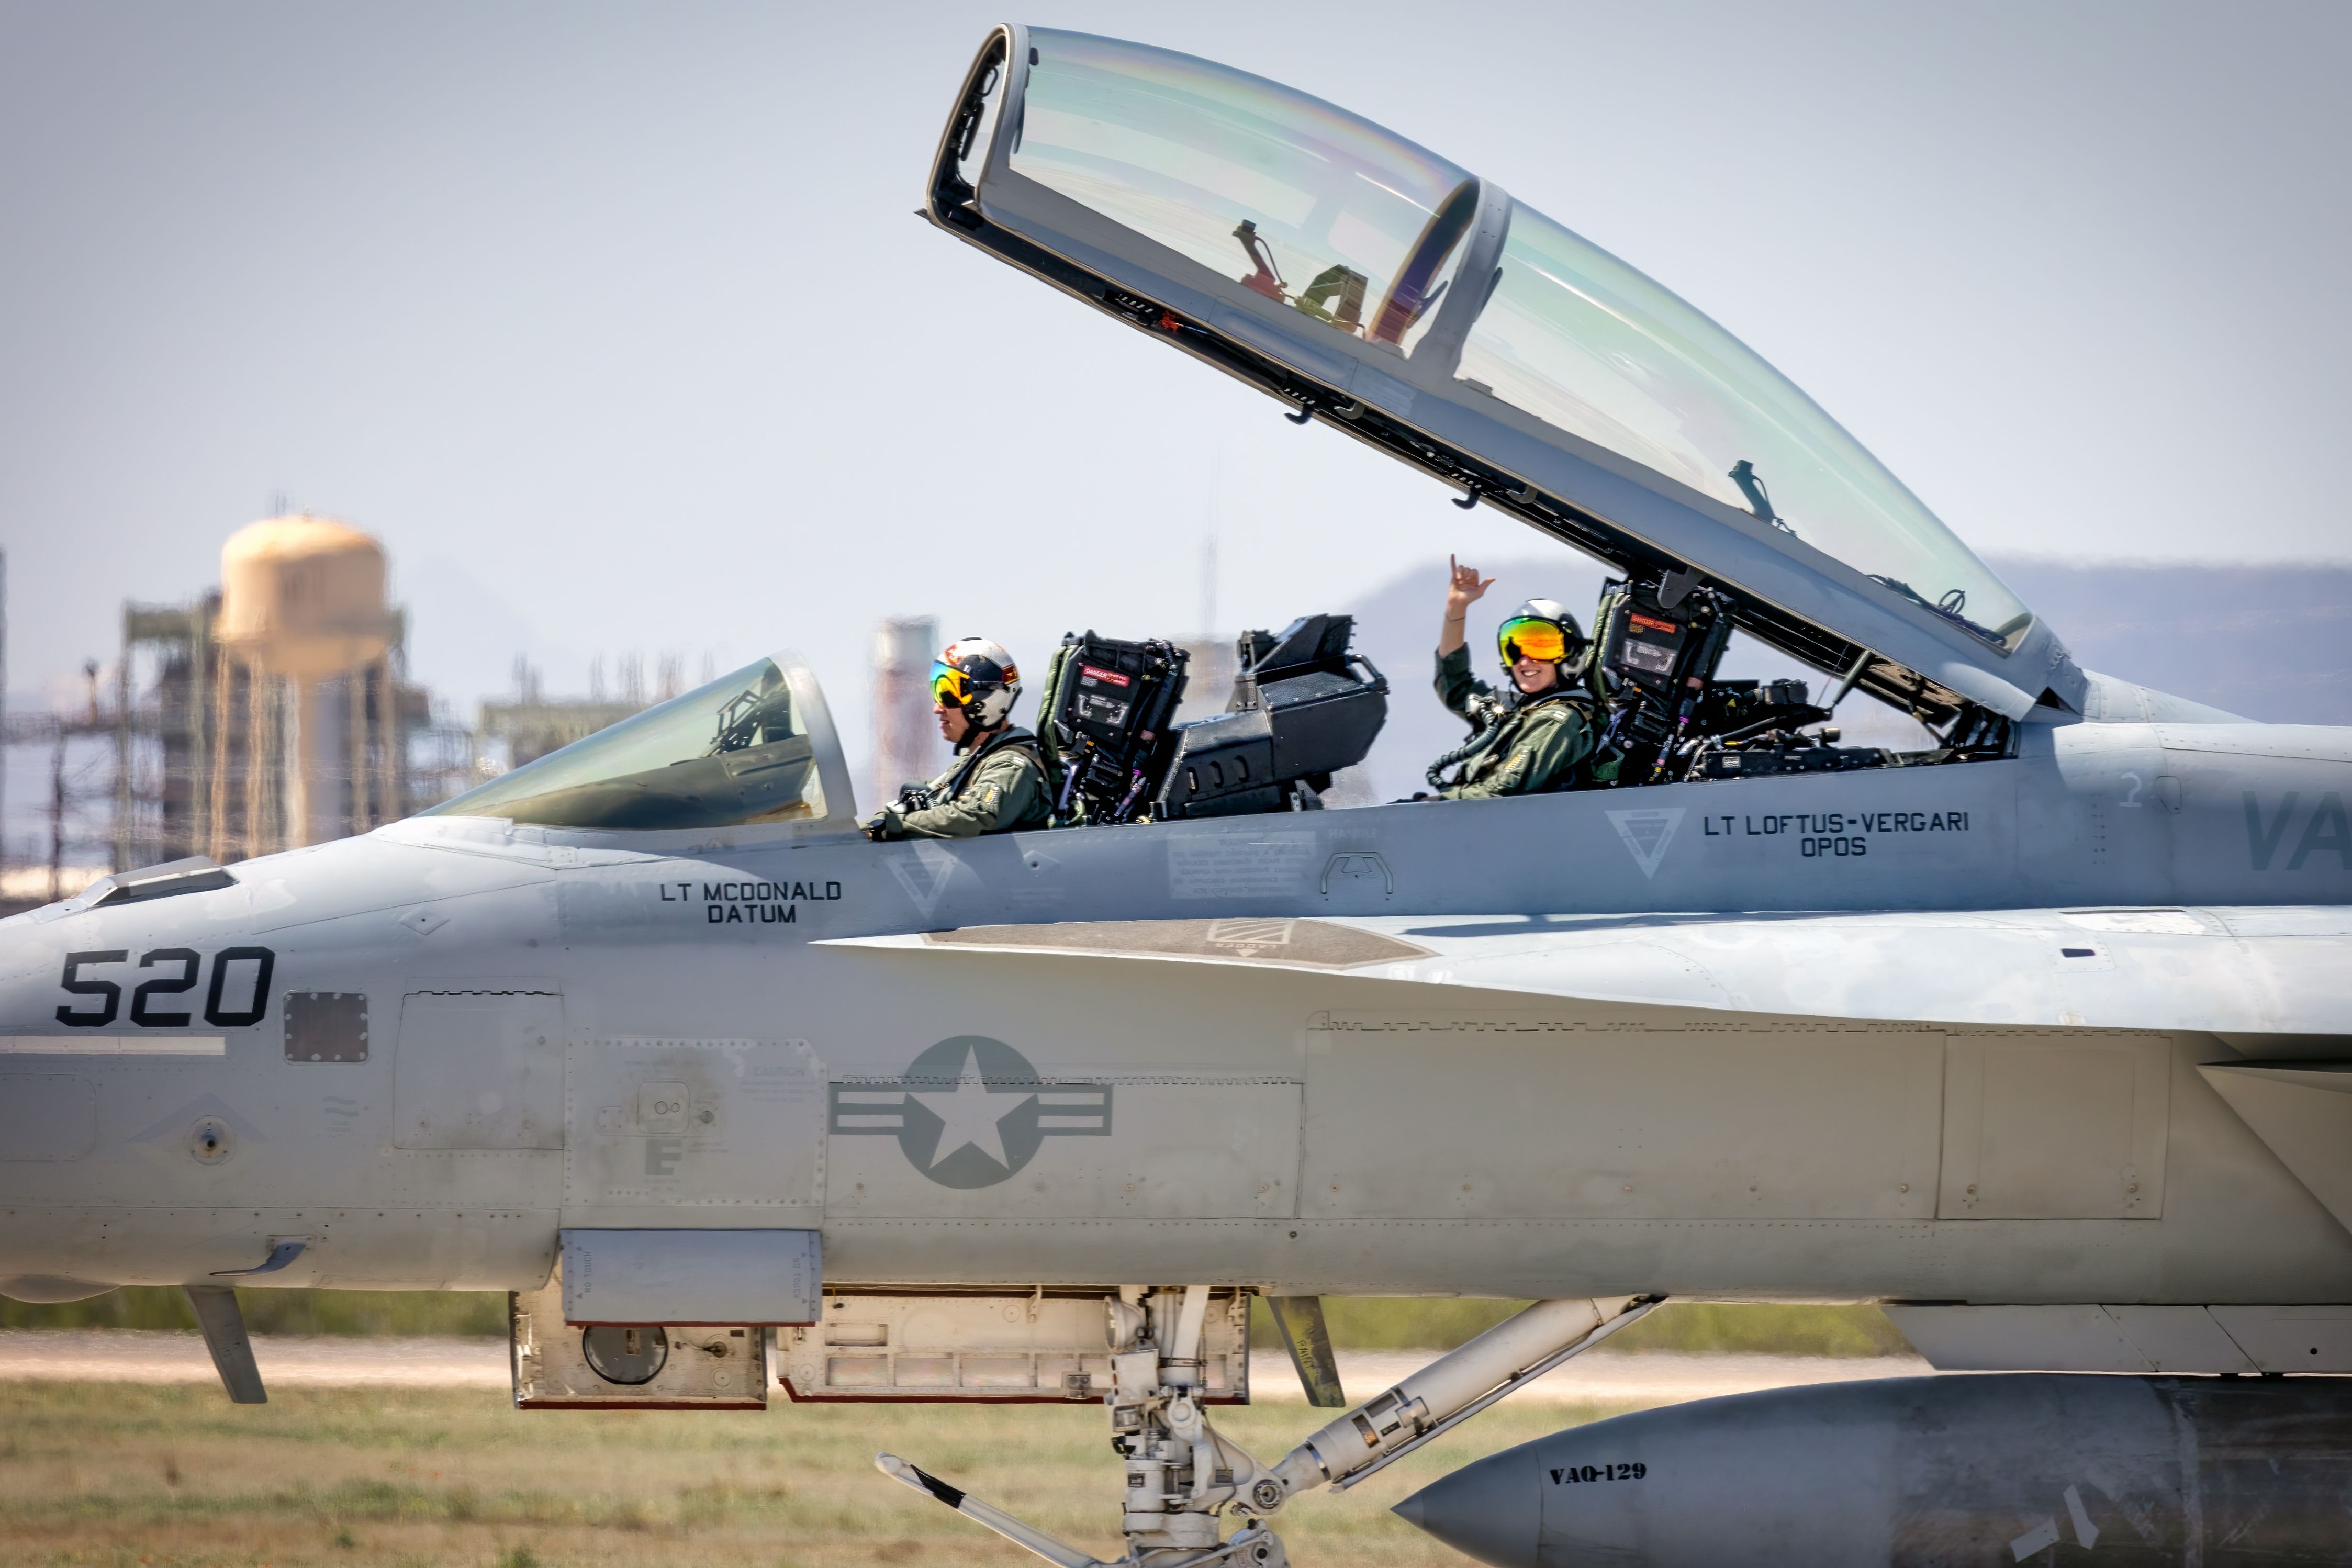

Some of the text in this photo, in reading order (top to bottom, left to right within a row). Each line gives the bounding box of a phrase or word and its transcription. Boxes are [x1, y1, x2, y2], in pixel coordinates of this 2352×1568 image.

[2118, 771, 2142, 808] 2
[1704, 811, 1969, 836] LT LOFTUS-VERGARI
[2241, 790, 2352, 871] VA
[1801, 836, 1867, 857] OPOS
[660, 880, 842, 901] LT MCDONALD
[708, 904, 797, 923] DATUM
[54, 946, 275, 1028] 520
[1550, 1462, 1647, 1485] VAQ-129
